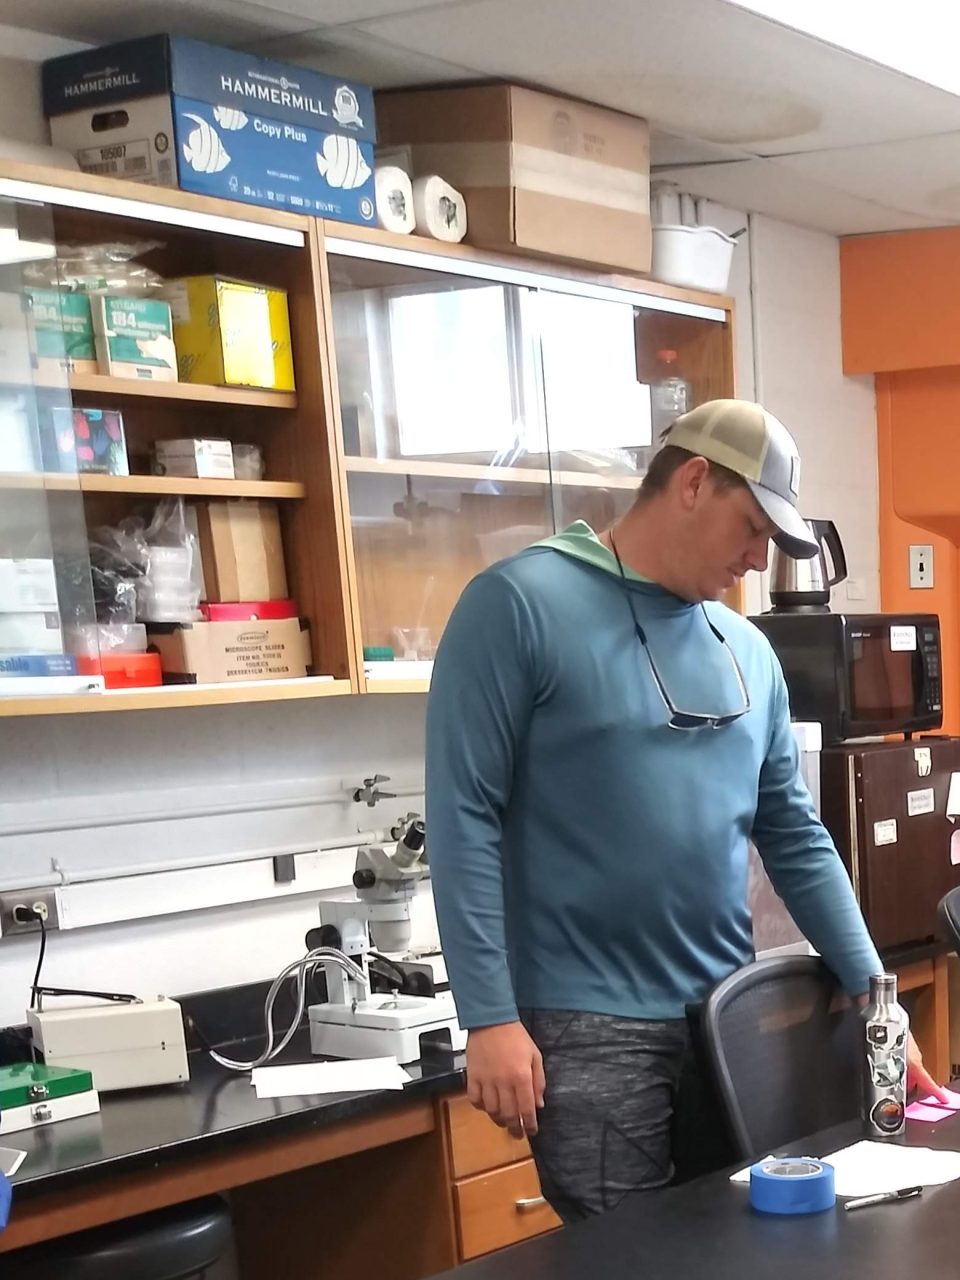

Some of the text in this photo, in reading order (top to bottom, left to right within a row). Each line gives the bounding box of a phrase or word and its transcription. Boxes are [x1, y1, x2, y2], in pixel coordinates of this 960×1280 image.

[64, 72, 140, 97] HAMMERMILL
[221, 76, 328, 116] HAMMERMILL
[254, 119, 307, 143] Copy Plus
[225, 645, 262, 653] MICROSCOPE
